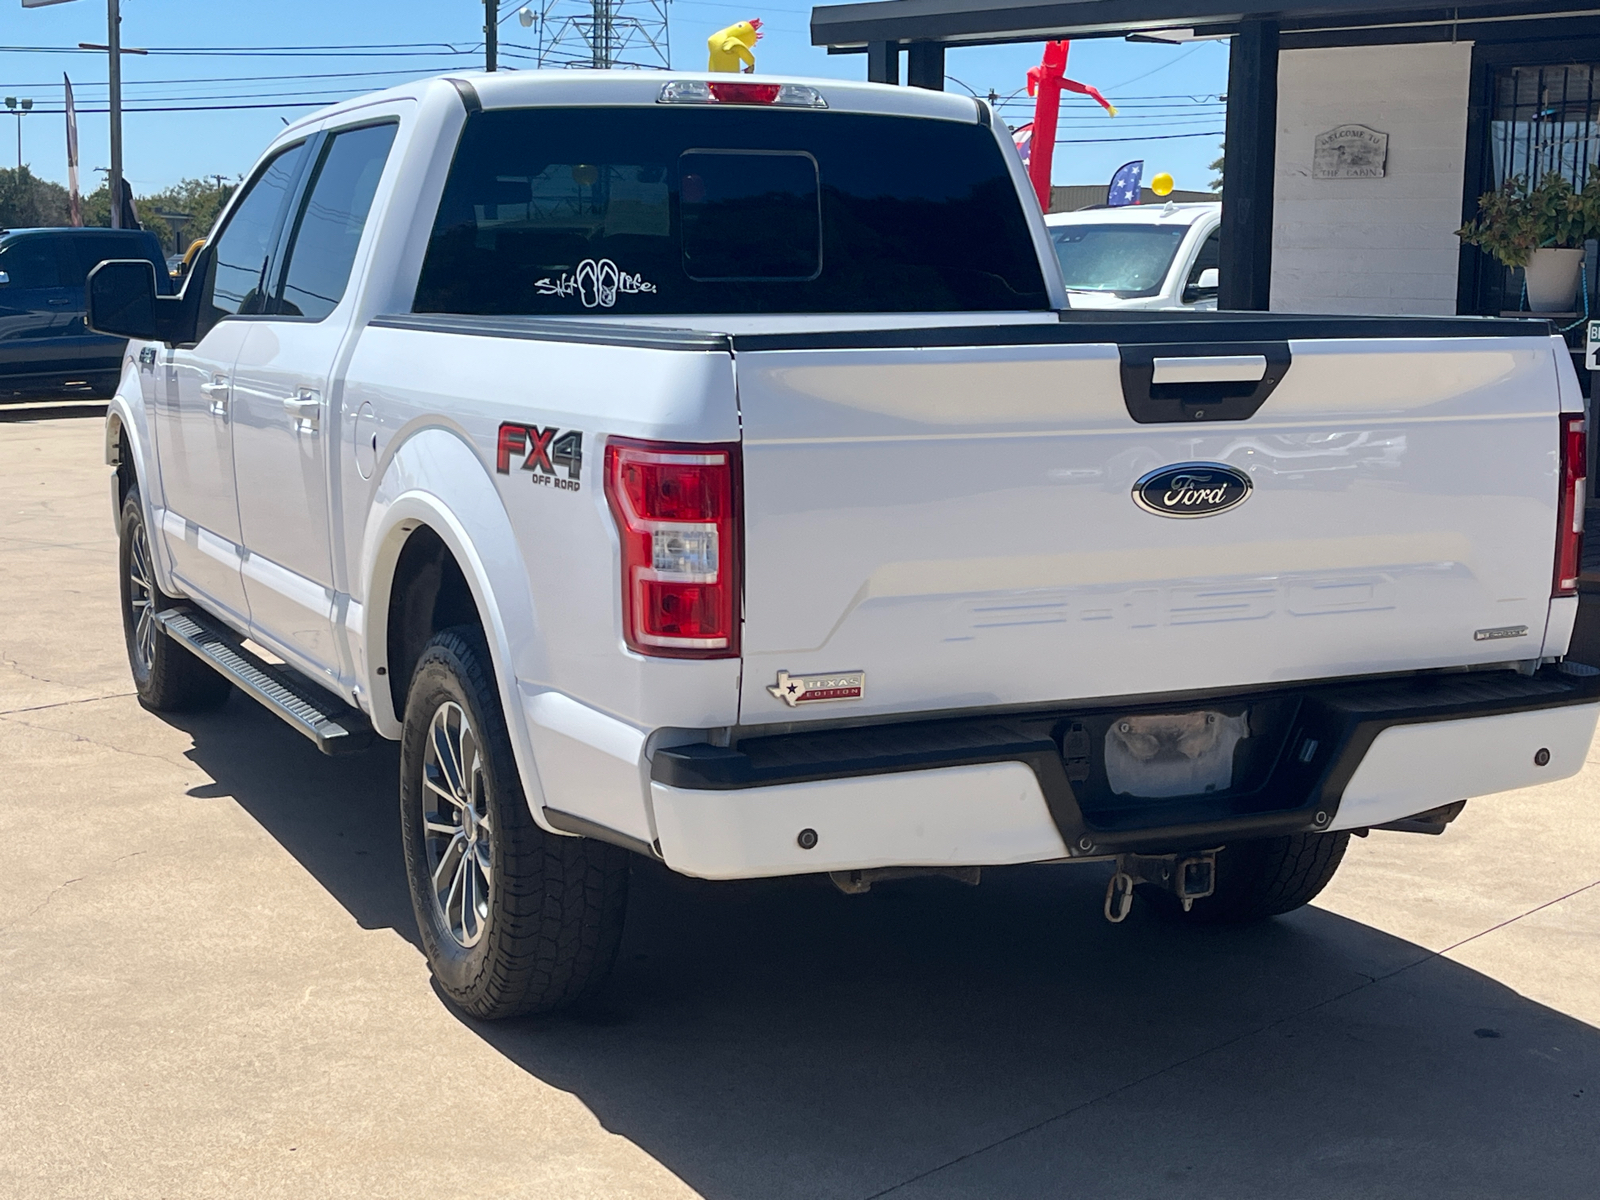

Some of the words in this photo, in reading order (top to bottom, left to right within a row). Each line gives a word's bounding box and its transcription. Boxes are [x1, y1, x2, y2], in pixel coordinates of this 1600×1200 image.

[1321, 130, 1366, 146] WELCOME
[1368, 133, 1380, 144] TO
[1321, 169, 1340, 177] THE
[1346, 168, 1377, 177] CABIN
[496, 420, 583, 480] FX4
[532, 473, 551, 486] OFF
[554, 477, 580, 492] ROAD
[1163, 474, 1229, 506] Ford
[808, 677, 859, 688] TEXAS
[806, 689, 858, 697] EDITION
